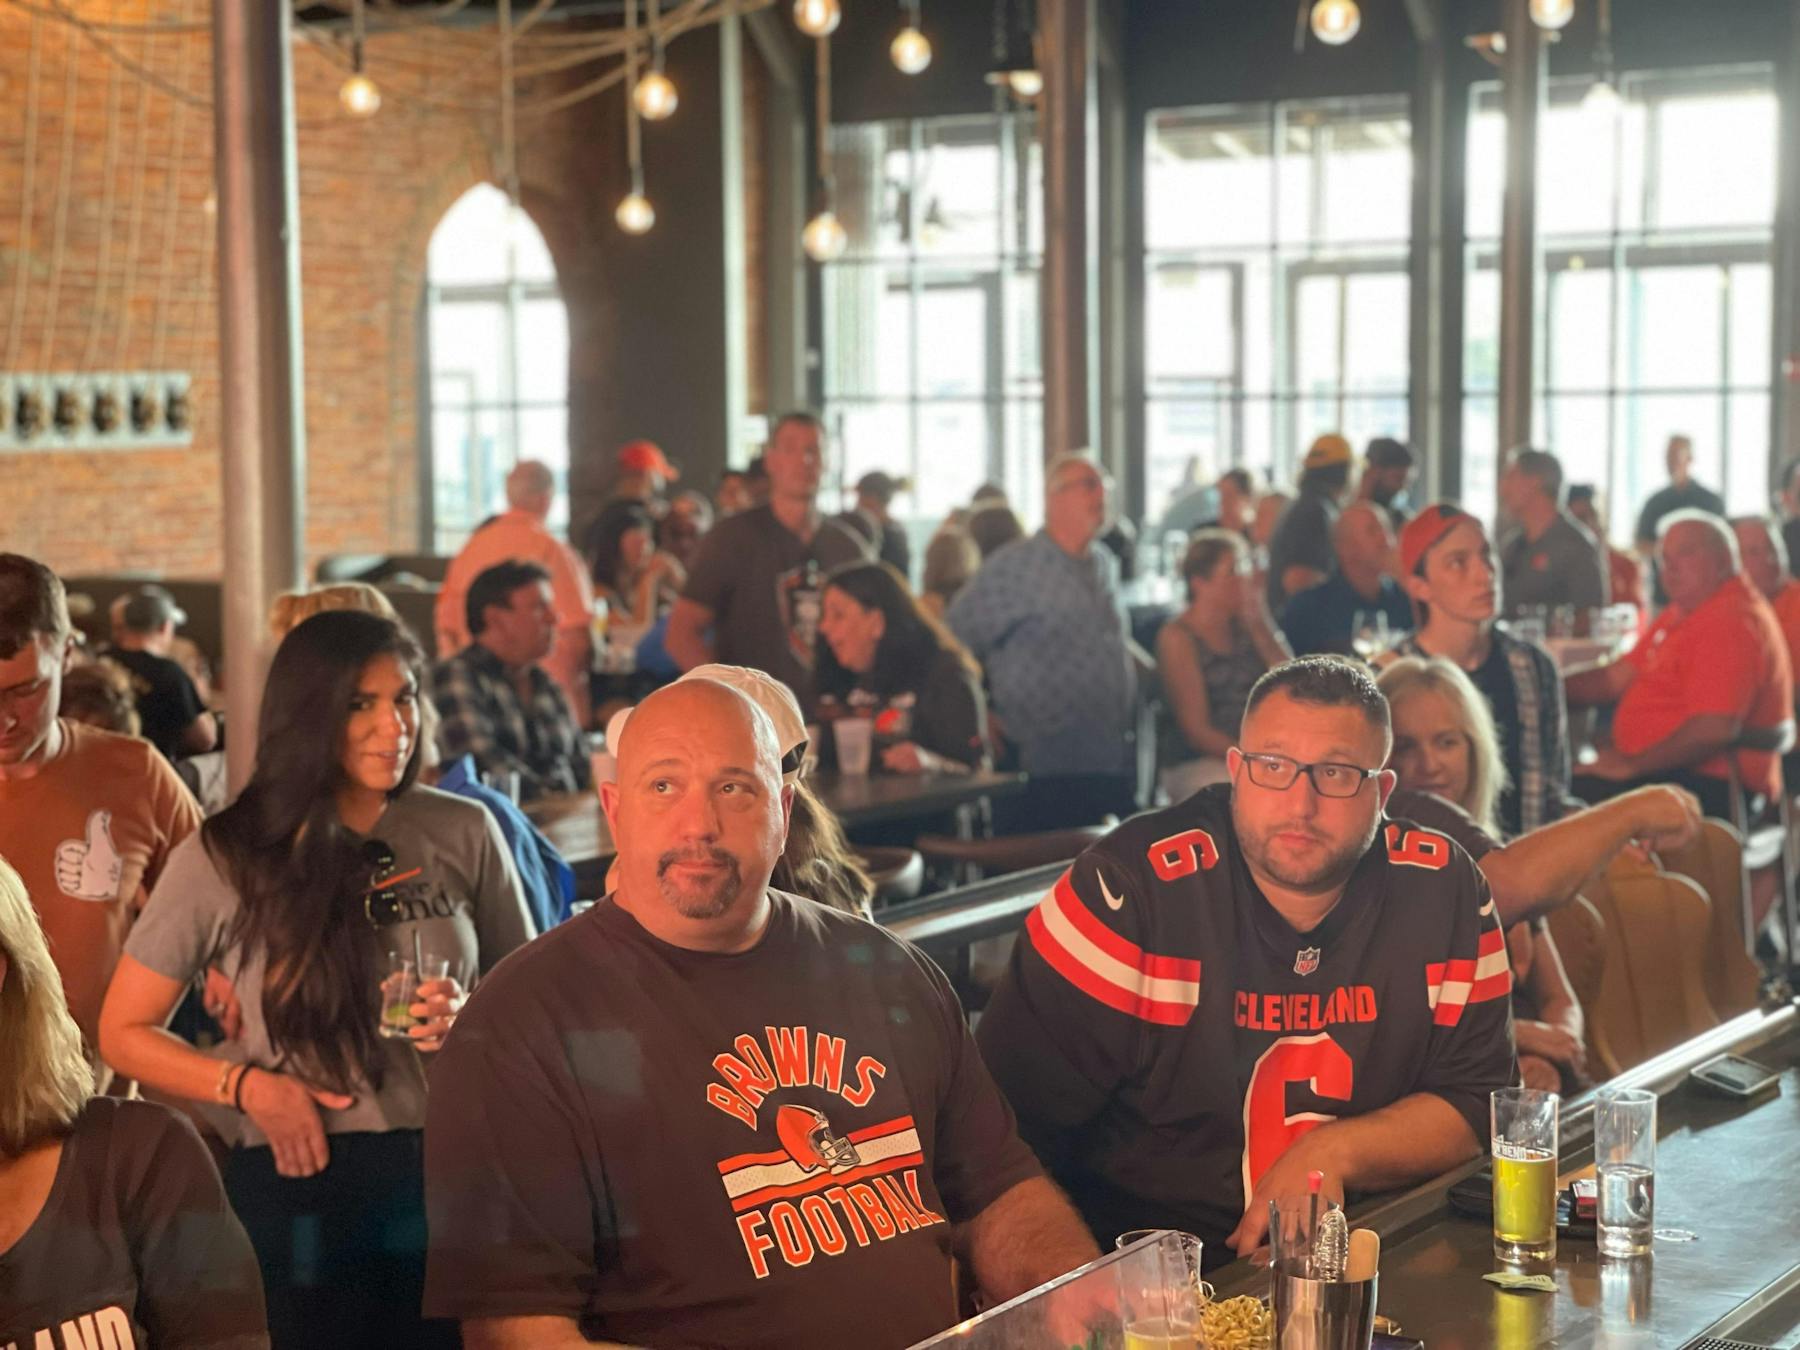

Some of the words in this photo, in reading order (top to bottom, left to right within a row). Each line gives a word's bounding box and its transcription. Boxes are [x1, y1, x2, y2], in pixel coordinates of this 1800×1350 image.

[1234, 985, 1377, 1031] CLEVELAND
[707, 1026, 886, 1131] BROWNS
[1242, 1031, 1353, 1212] 6
[736, 1169, 945, 1279] FOOTBALL
